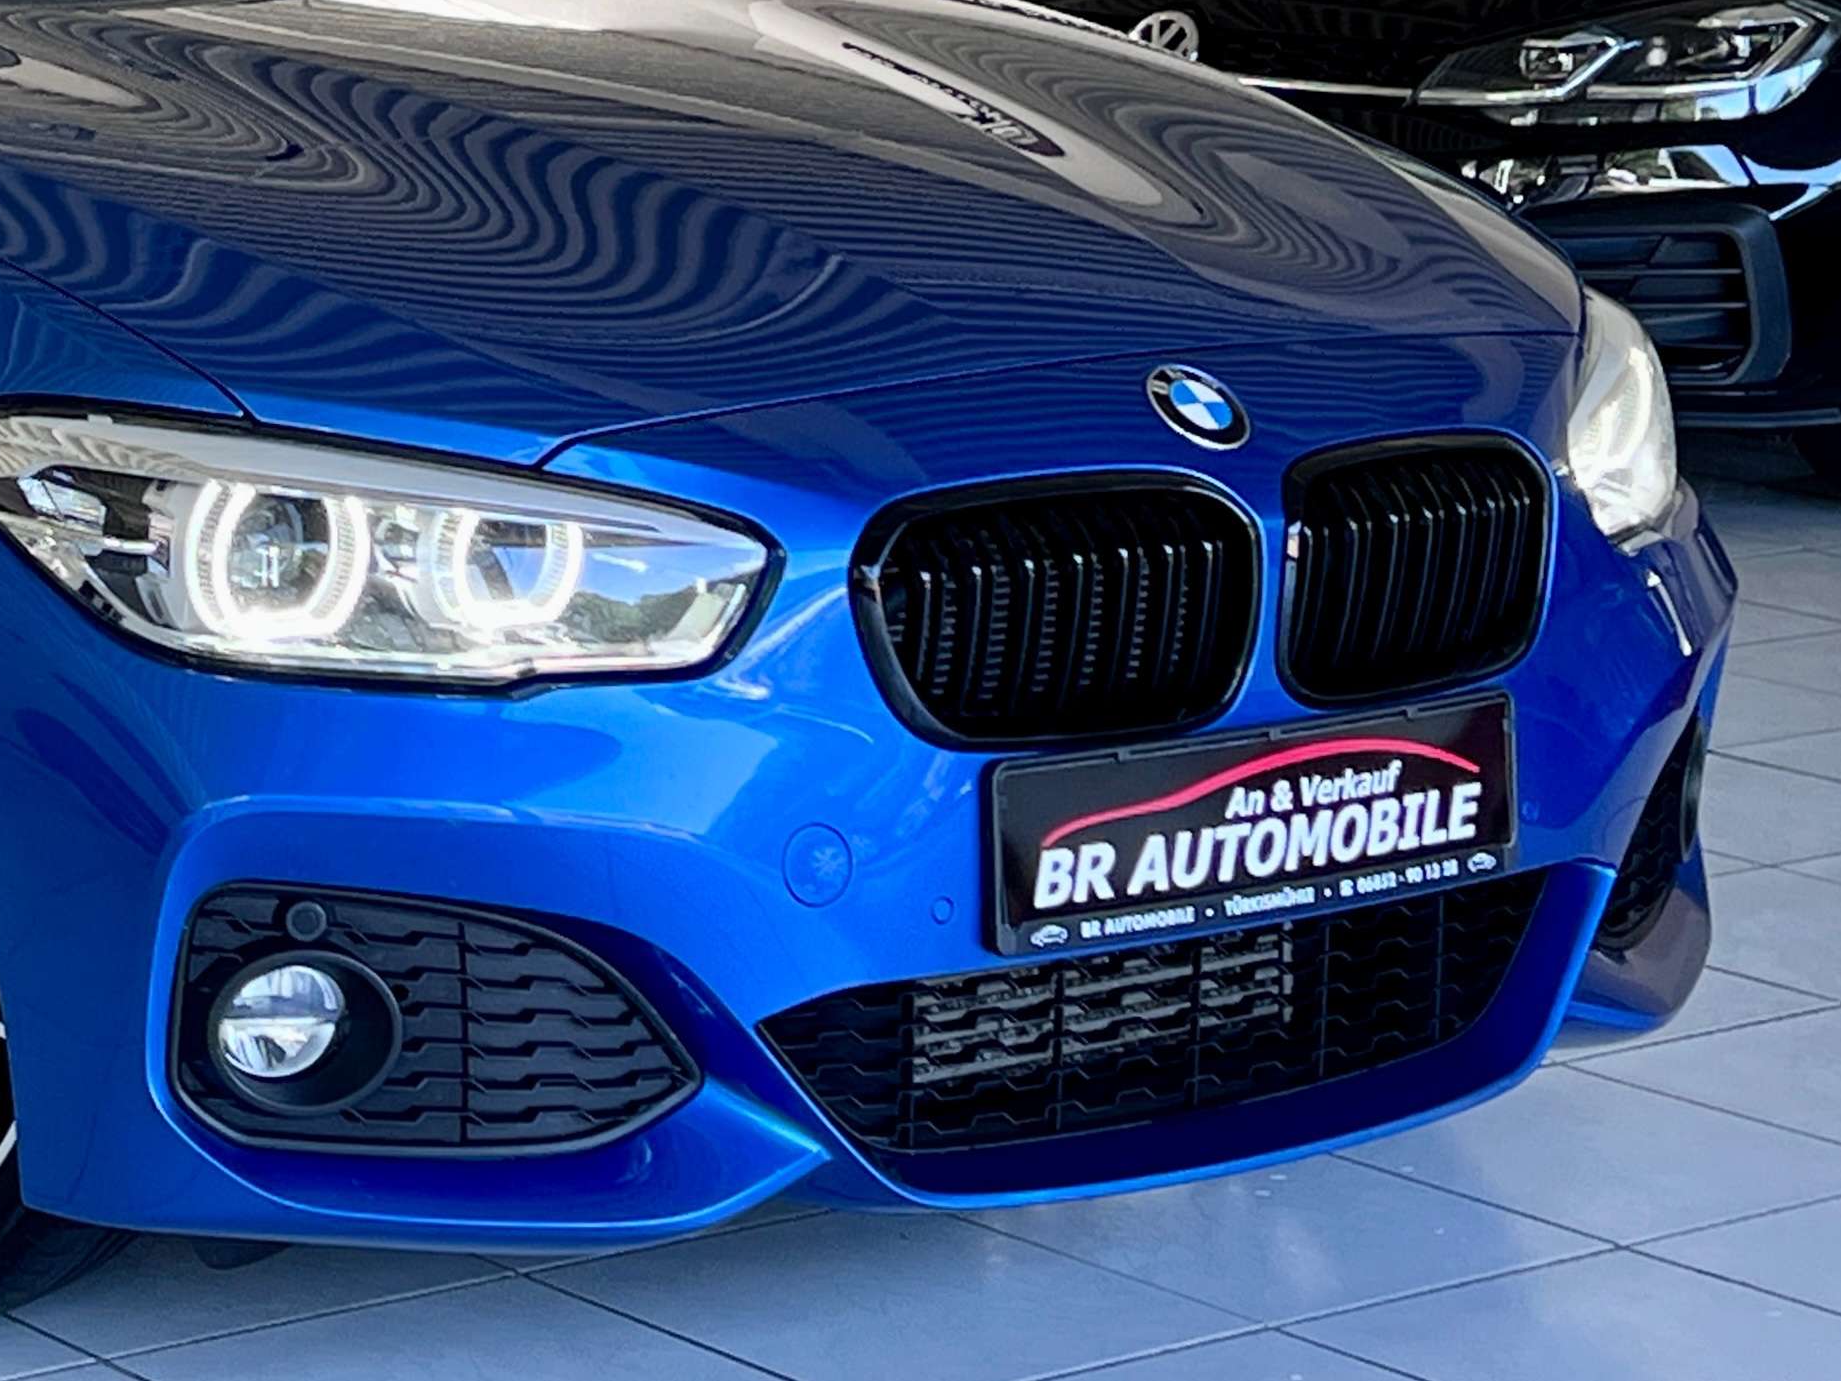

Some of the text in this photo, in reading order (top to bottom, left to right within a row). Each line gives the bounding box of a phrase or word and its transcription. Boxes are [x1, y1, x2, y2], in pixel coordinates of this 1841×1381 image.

[1225, 760, 1402, 820] An & Verkauf
[1033, 781, 1483, 910] BR AUTOMOBILE
